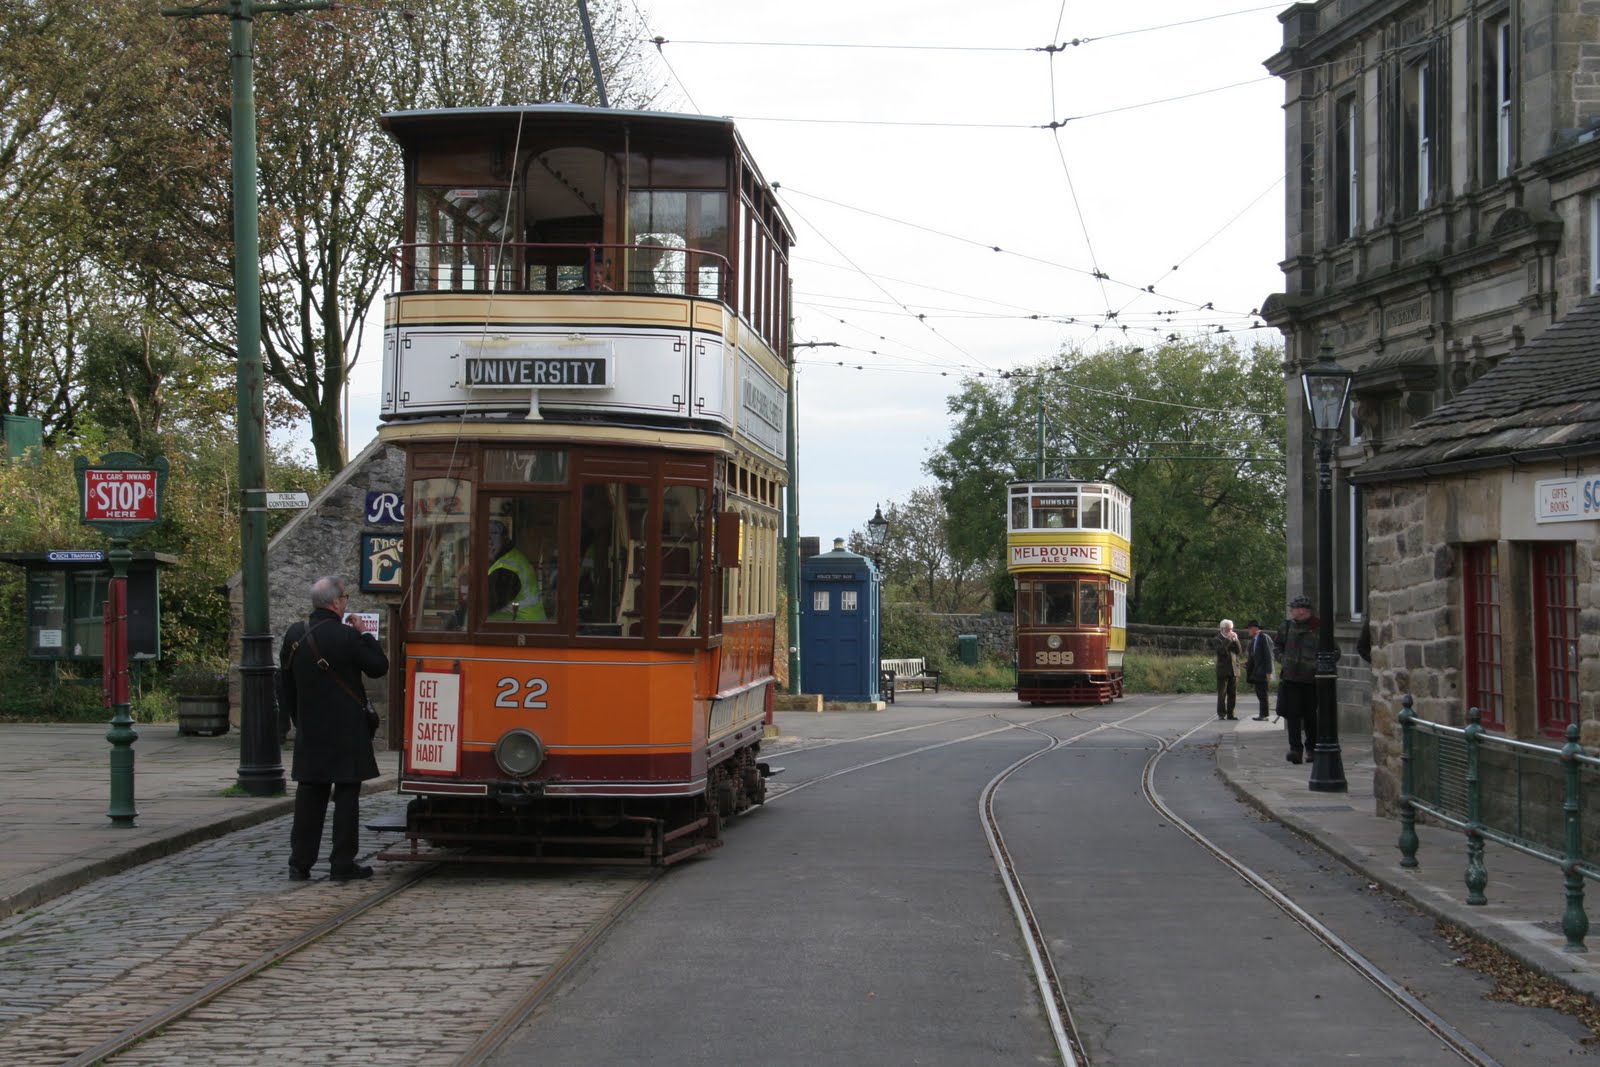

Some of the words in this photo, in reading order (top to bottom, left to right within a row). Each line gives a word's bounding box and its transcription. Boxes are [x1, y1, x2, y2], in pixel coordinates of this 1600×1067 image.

[470, 360, 595, 384] UNIVERSITY
[96, 481, 147, 510] STOP
[1551, 488, 1568, 499] GIFTS
[268, 500, 308, 508] CONVENIENCES
[1549, 500, 1570, 513] BOOKS
[370, 537, 396, 553] The
[1014, 546, 1098, 561] MELBOURNE
[70, 552, 101, 560] TRAMWAYS
[1035, 651, 1075, 665] 399
[419, 680, 439, 698] GET
[495, 676, 549, 710] 22
[418, 701, 438, 720] THE
[417, 722, 456, 742] SAFETY
[415, 744, 444, 763] HABIT
